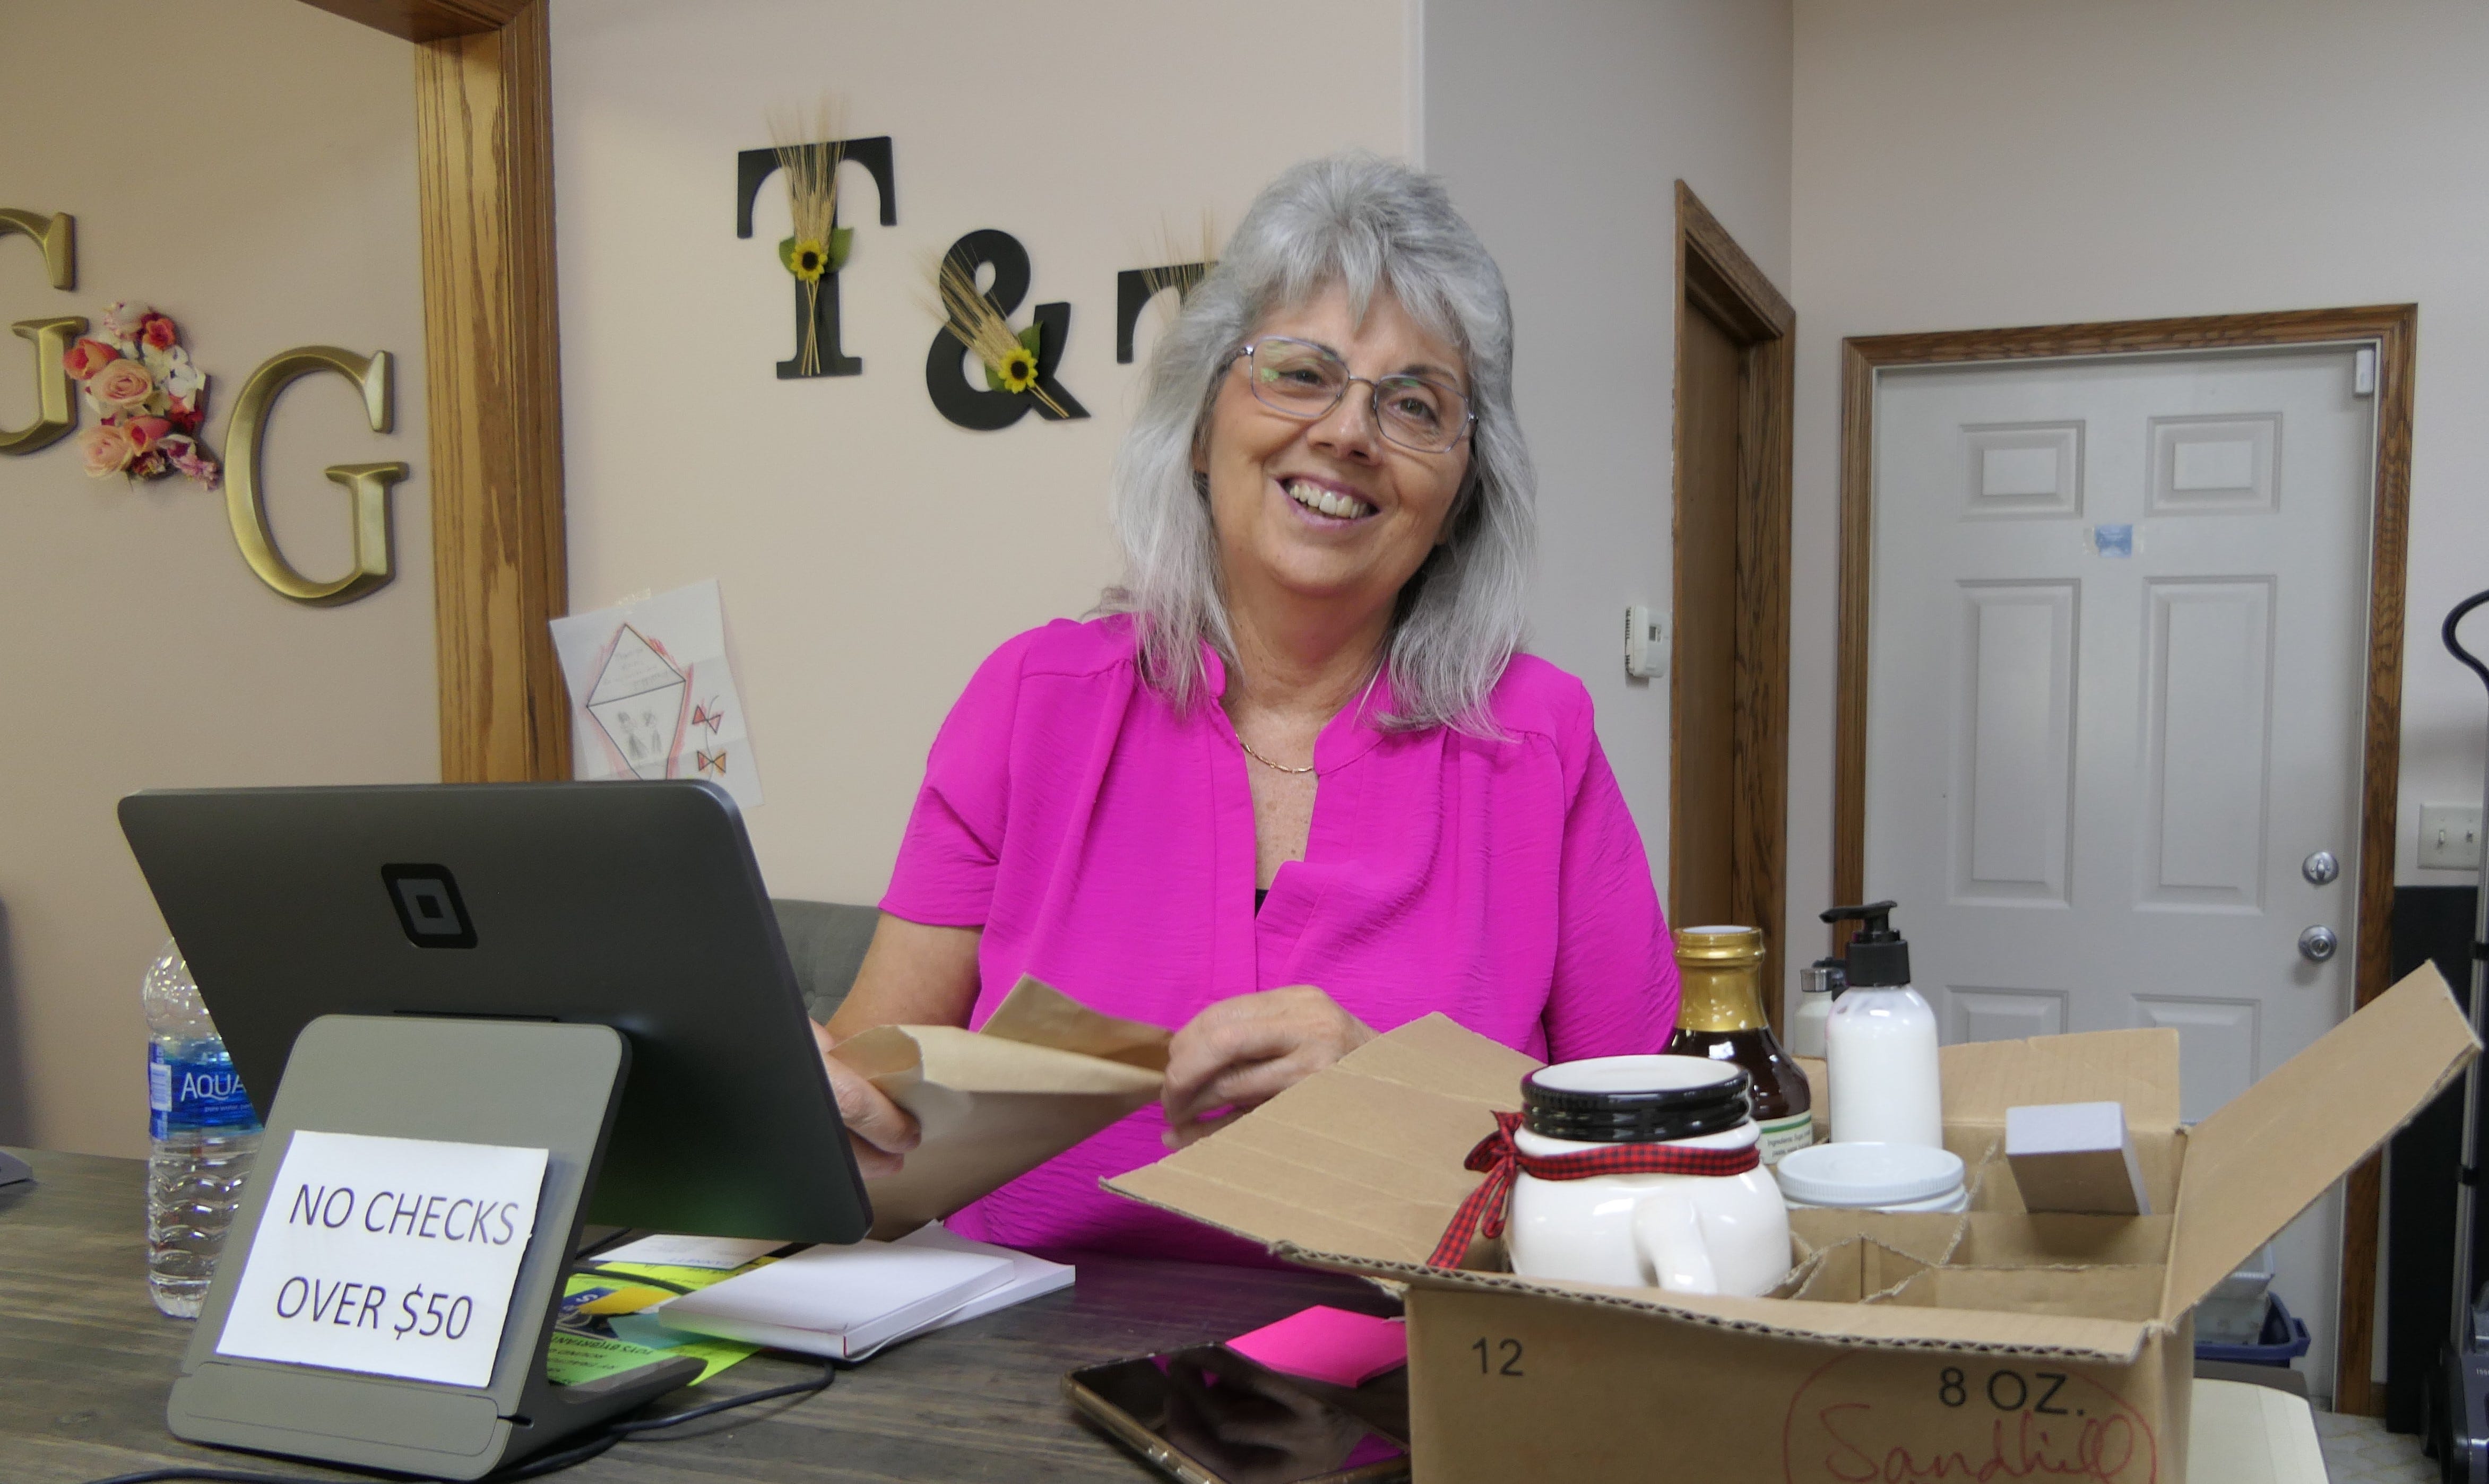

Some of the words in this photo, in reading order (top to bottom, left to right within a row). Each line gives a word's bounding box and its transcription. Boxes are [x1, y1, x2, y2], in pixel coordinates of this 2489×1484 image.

[737, 135, 897, 379] T
[926, 229, 1092, 431] &
[224, 345, 409, 608] G
[289, 1184, 355, 1228] NO
[365, 1191, 518, 1246] CHECKS
[276, 1277, 387, 1330] OVER
[394, 1283, 473, 1340] $50
[1472, 1336, 1524, 1376] 12
[1939, 1366, 1967, 1408] 8
[1987, 1369, 2086, 1417] OZ.
[1819, 1402, 2134, 1484] Sandhill
